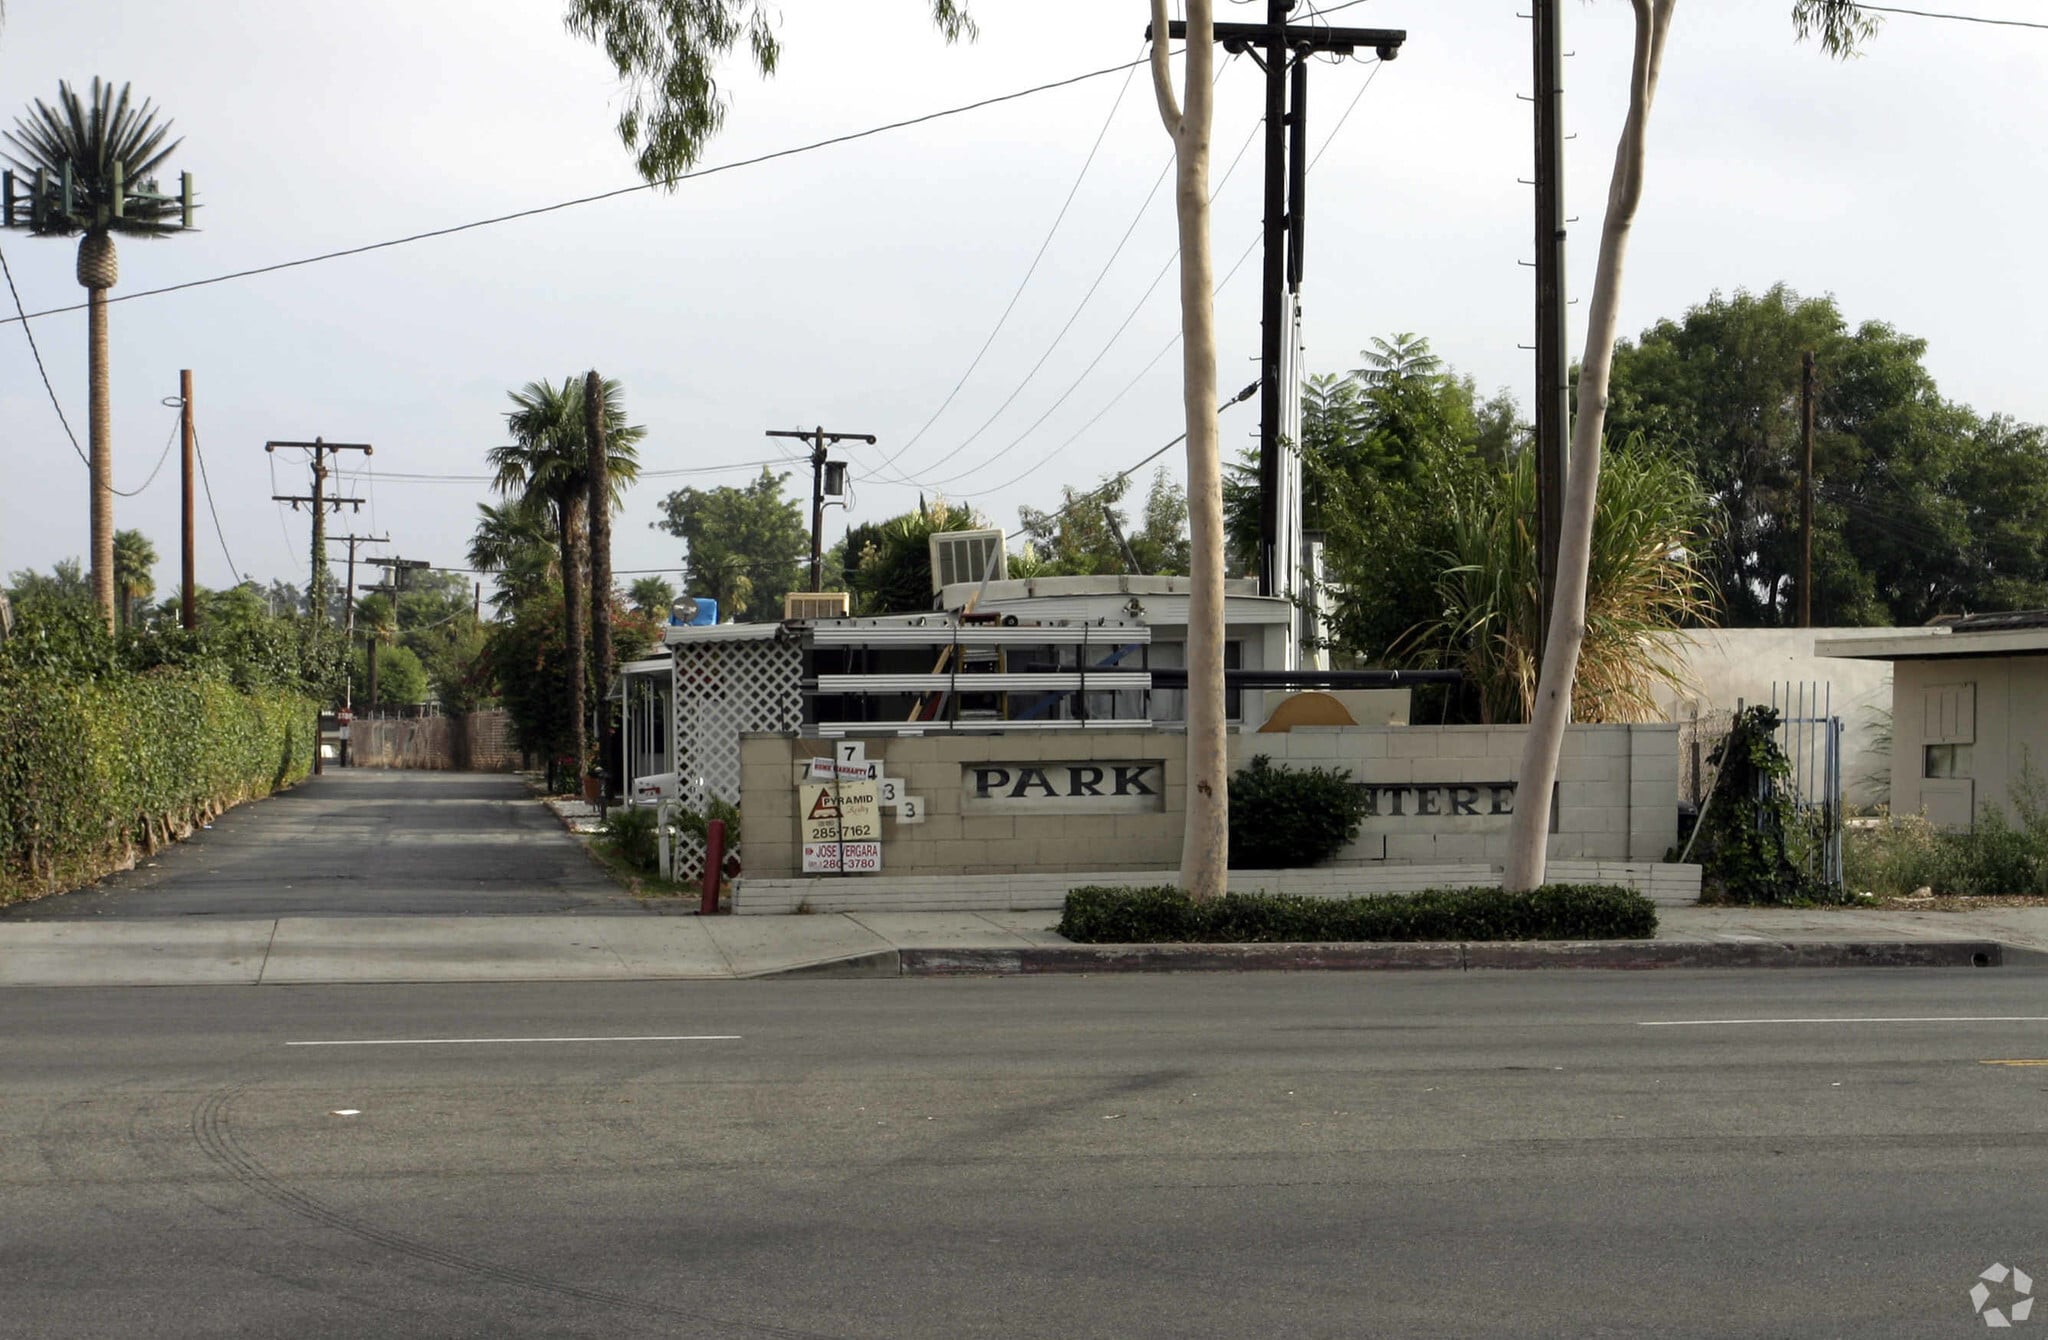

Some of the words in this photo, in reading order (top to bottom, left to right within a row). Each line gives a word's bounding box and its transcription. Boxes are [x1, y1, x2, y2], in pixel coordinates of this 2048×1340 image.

[834, 765, 868, 775] ARRANTY
[844, 746, 856, 761] 7
[868, 764, 878, 780] 4
[883, 783, 895, 800] 3
[904, 802, 916, 817] 3
[972, 766, 1159, 798] PARK
[823, 794, 874, 806] PYRAMID
[812, 824, 871, 839] 285-7162
[816, 844, 837, 858] JOSE
[823, 859, 875, 869] 280-3780
